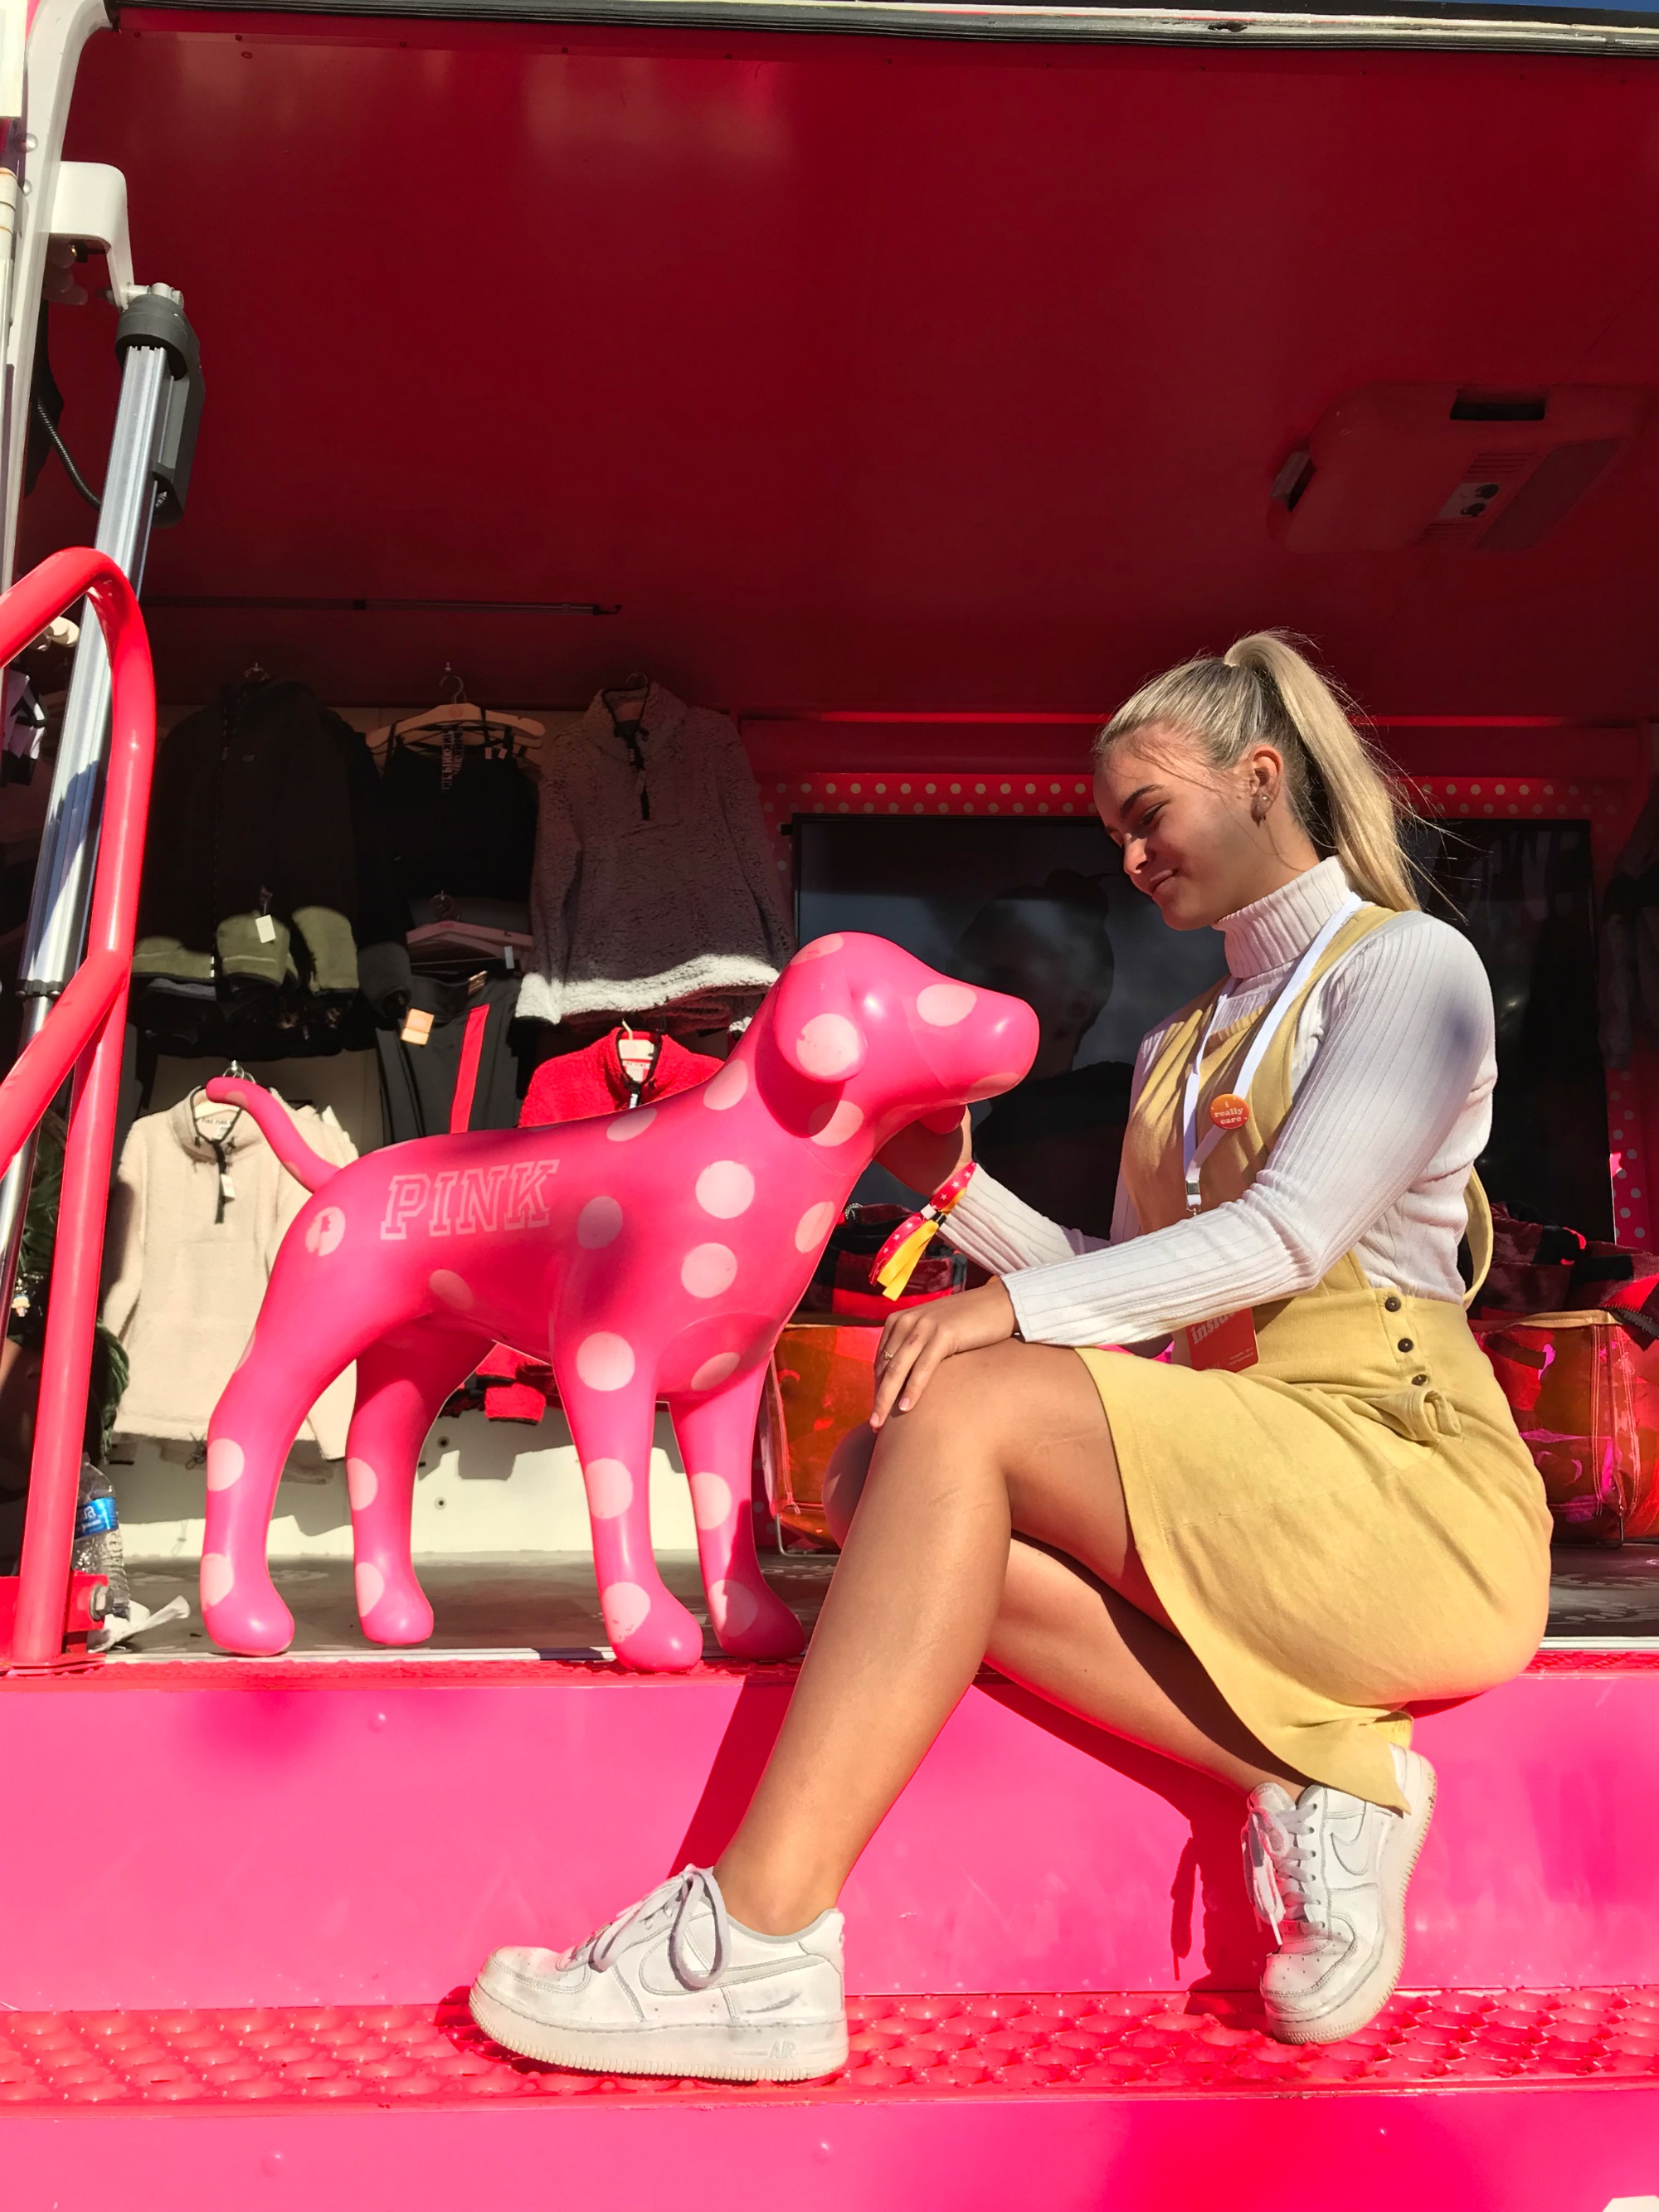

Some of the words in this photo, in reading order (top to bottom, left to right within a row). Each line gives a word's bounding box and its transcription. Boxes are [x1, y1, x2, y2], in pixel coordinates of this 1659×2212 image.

[1214, 1107, 1243, 1117] really
[1220, 1116, 1243, 1125] care
[380, 1159, 561, 1240] PINK
[770, 2040, 795, 2059] AIR
